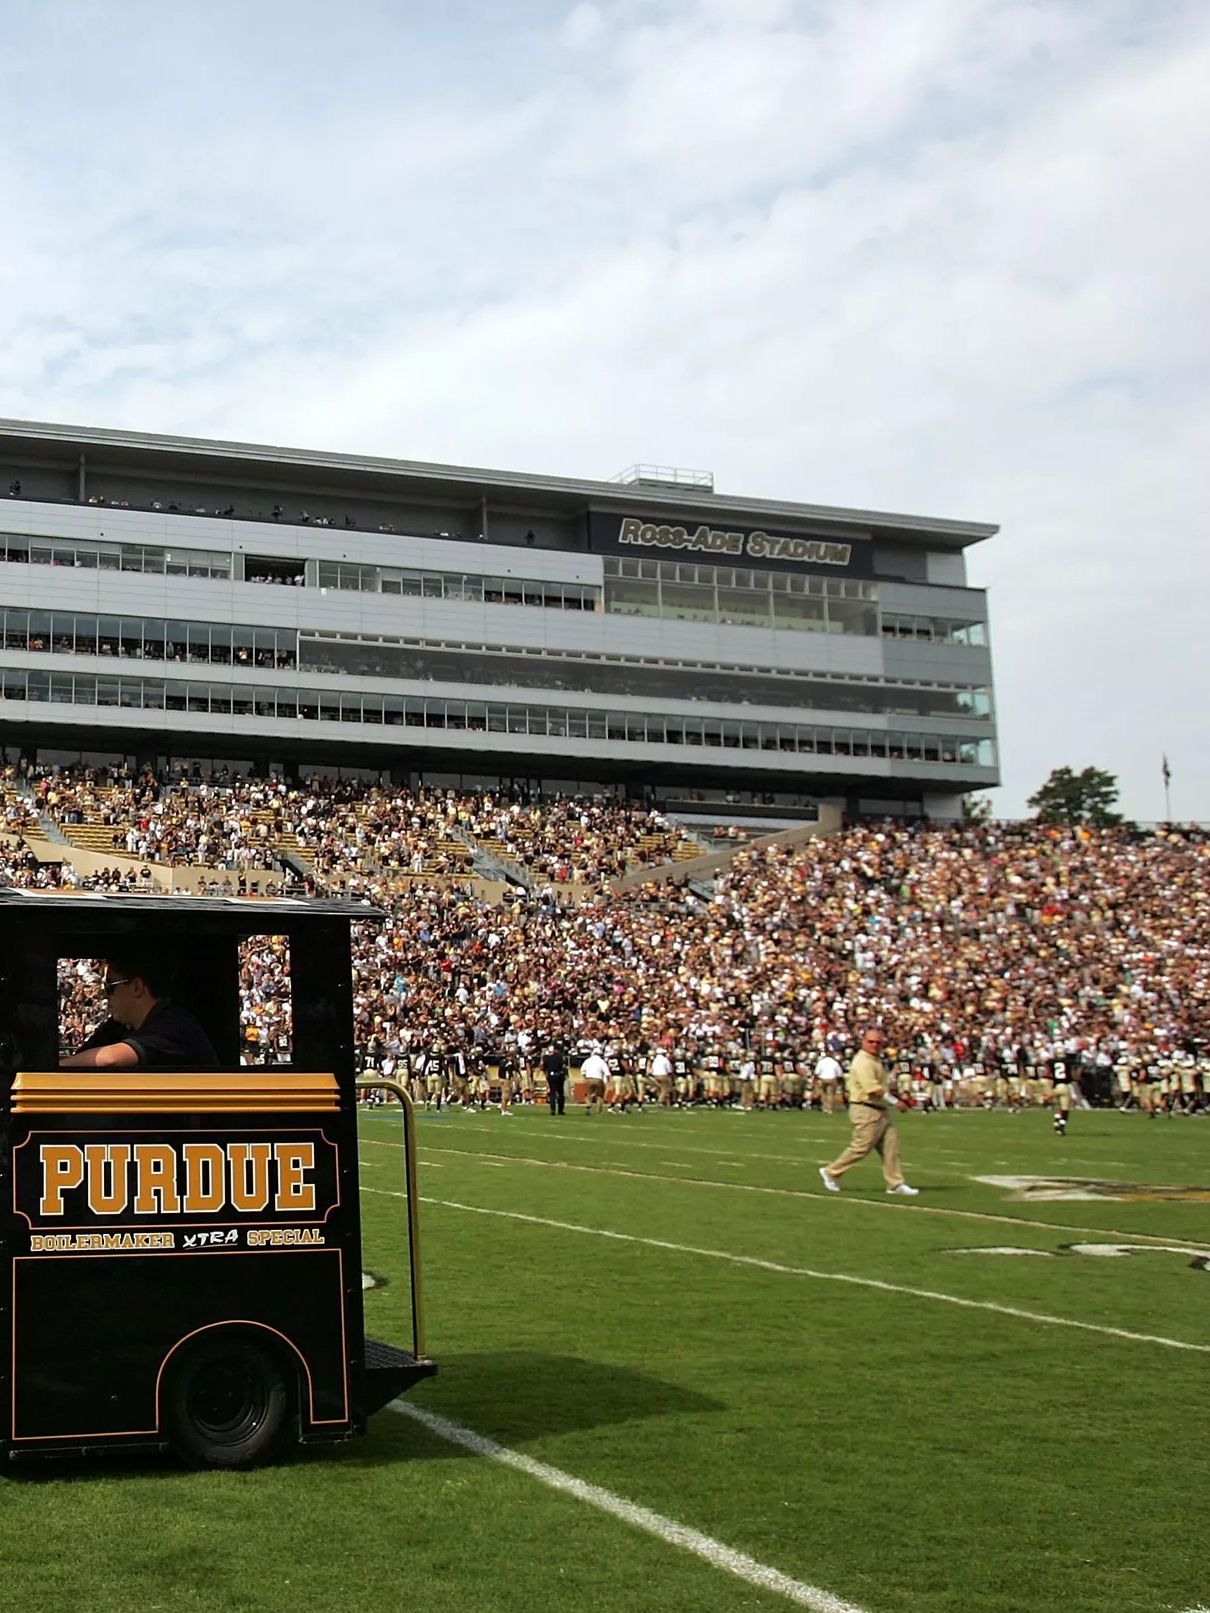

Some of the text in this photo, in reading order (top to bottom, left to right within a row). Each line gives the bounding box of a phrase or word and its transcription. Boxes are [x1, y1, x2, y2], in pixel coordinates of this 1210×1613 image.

[618, 518, 852, 566] ROSS-ADE STADIUM
[364, 1056, 375, 1068] 71
[1053, 1062, 1066, 1079] 2
[40, 1143, 315, 1215] PURDUE
[30, 1232, 175, 1251] BOILERMAKER
[246, 1228, 326, 1246] SPECIAL
